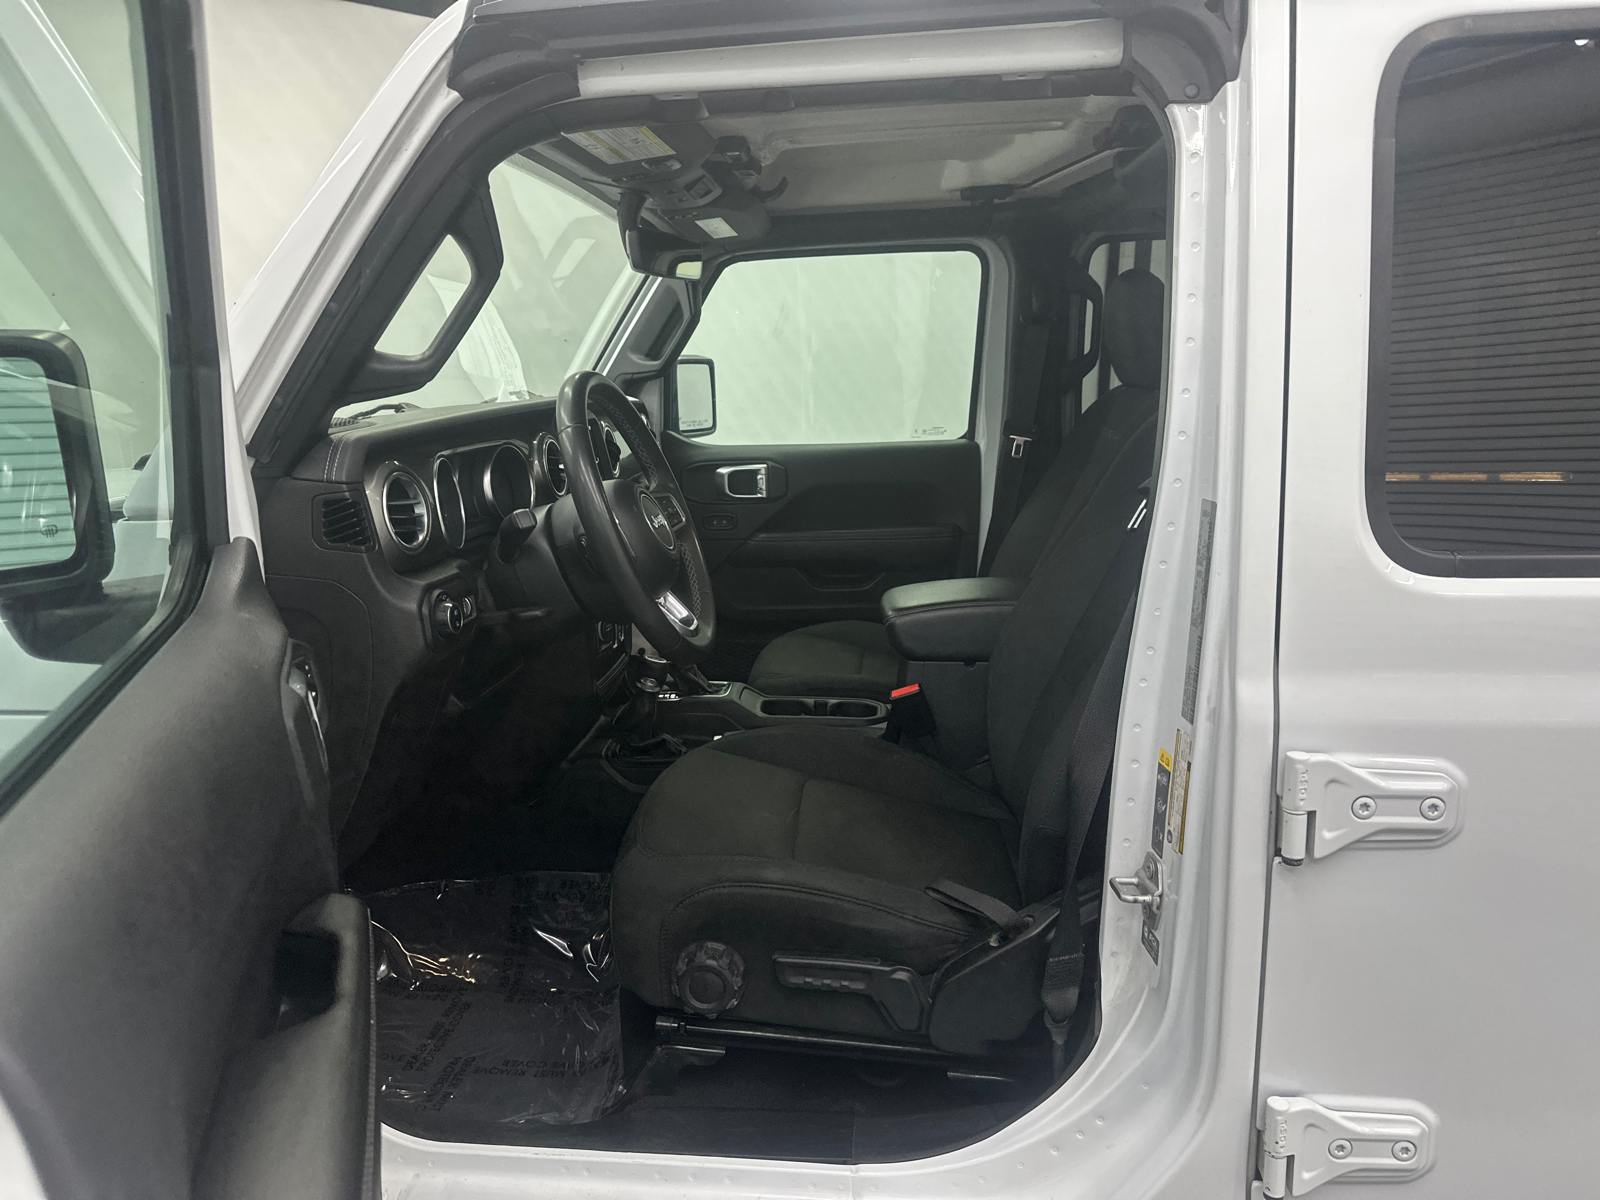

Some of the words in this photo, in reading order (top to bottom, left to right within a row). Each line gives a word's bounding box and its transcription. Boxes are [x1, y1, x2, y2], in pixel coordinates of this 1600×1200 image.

[559, 879, 600, 890] COVER
[501, 1059, 547, 1068] COVER
[471, 1066, 526, 1076] REMOVE
